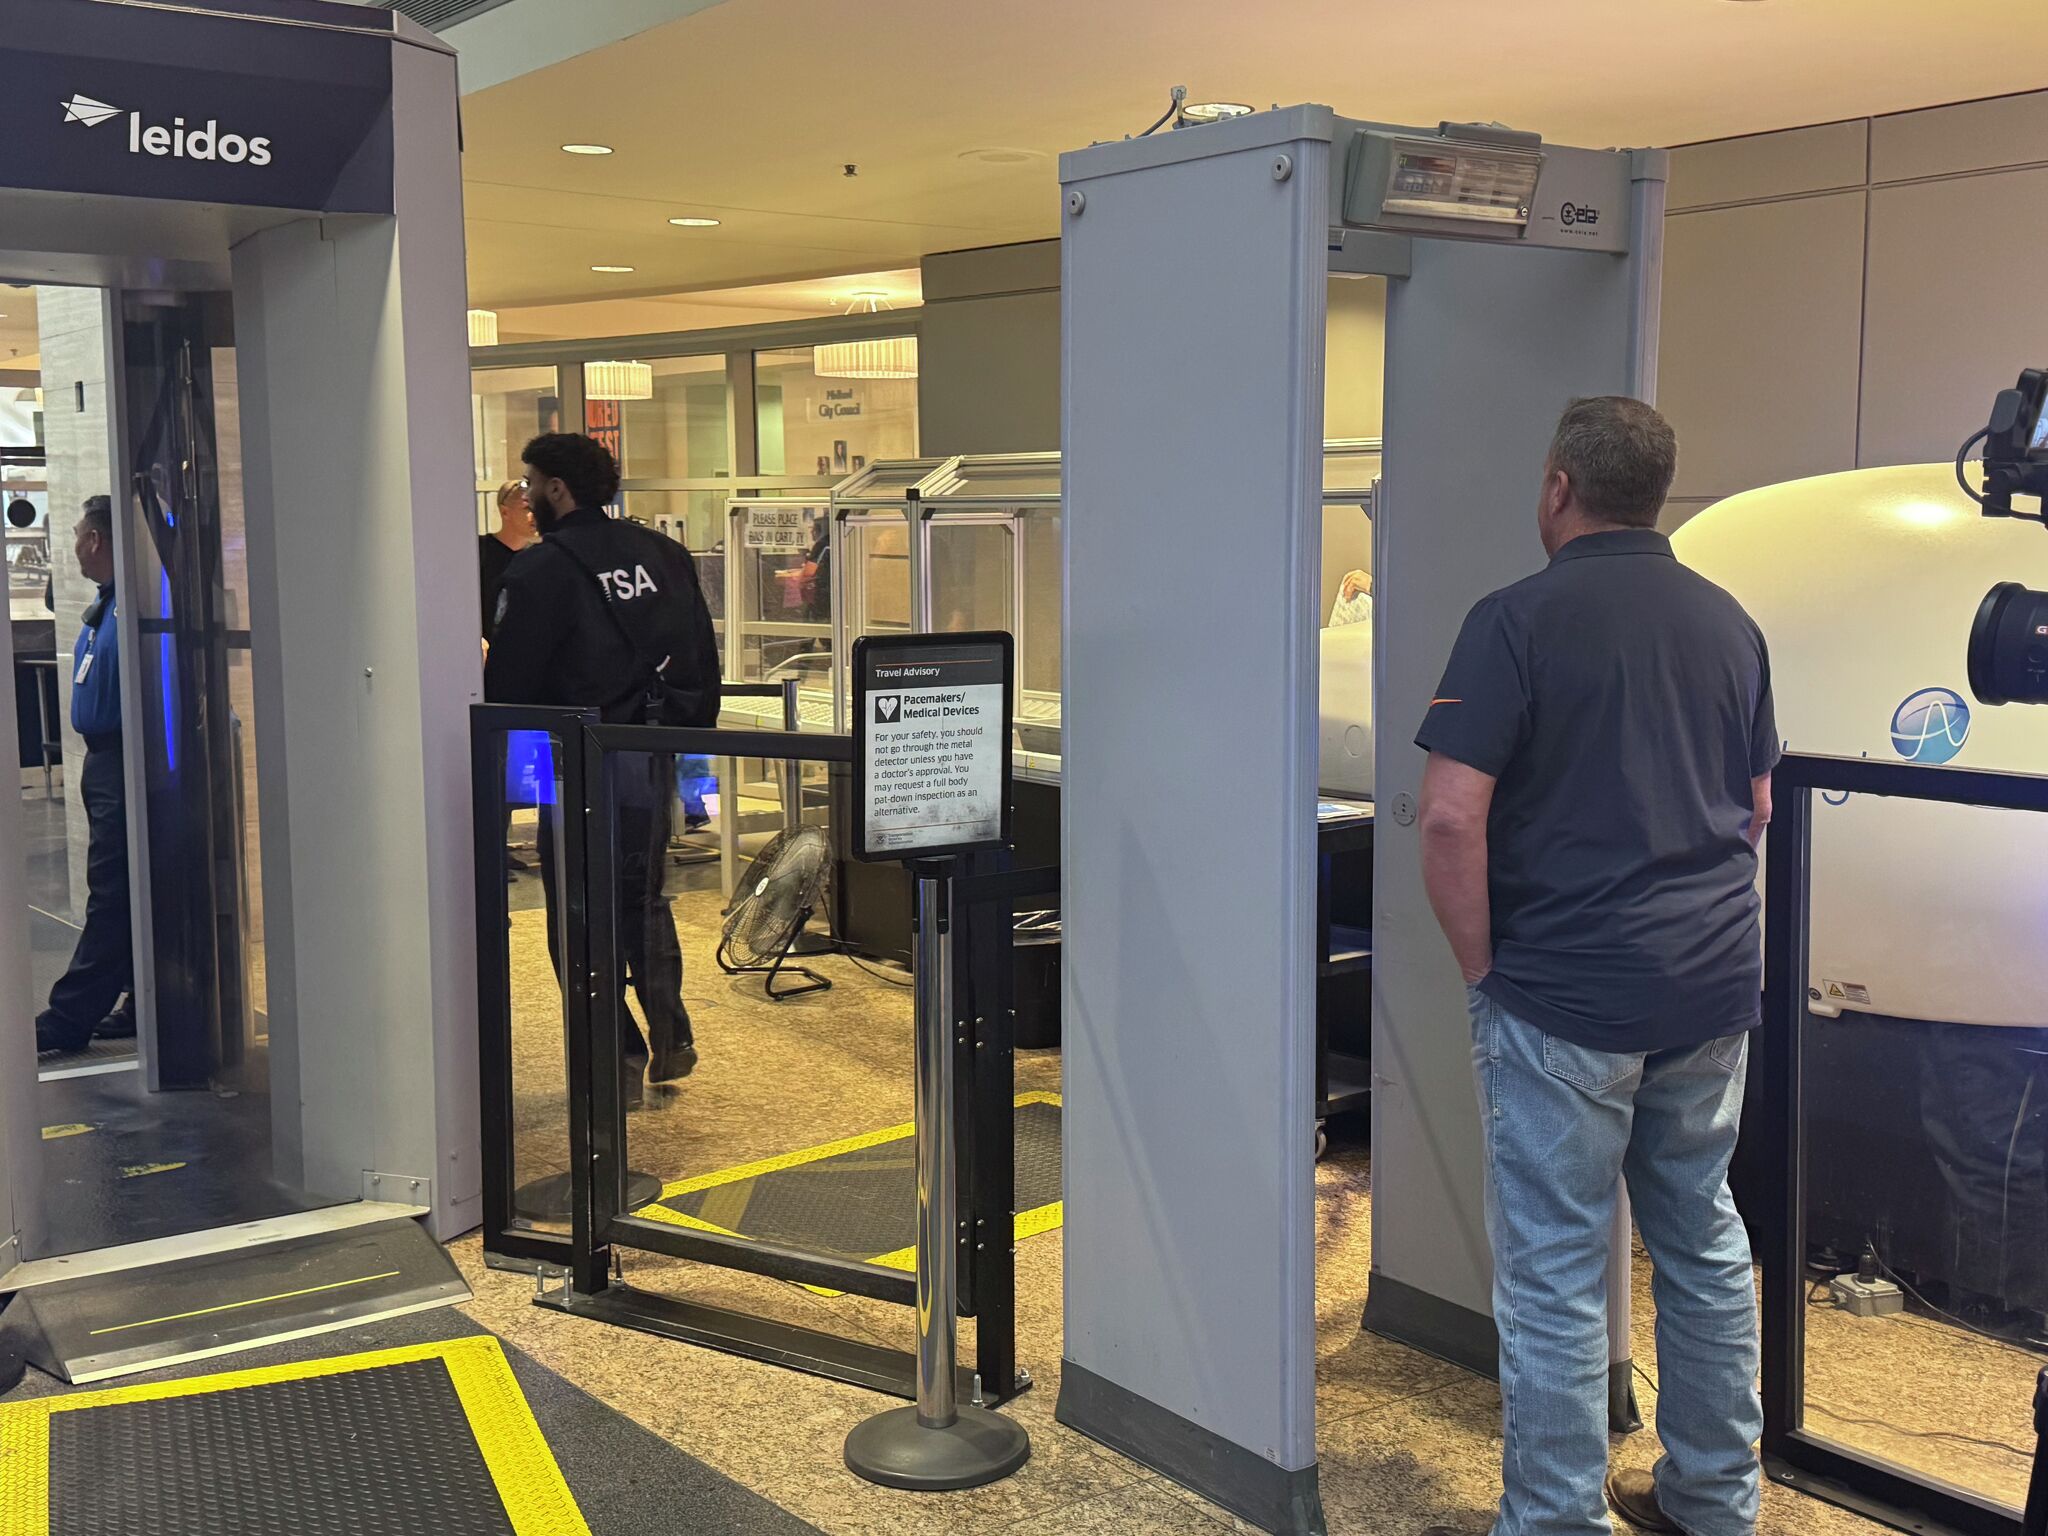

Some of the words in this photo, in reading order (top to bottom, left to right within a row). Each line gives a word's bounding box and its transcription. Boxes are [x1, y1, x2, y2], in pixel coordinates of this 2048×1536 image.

[130, 111, 272, 166] leidos
[752, 513, 776, 525] PLEASE
[777, 513, 798, 525] PLACE
[748, 531, 764, 542] BINS
[596, 564, 658, 602] TSA
[875, 668, 902, 678] Travel
[903, 667, 940, 677] Advisory
[903, 692, 966, 705] Pacemakers/
[903, 707, 940, 719] Medical
[943, 706, 980, 717] Devices
[875, 733, 888, 742] For
[891, 732, 909, 742] your
[911, 730, 938, 740] safety,
[940, 730, 955, 740] you
[957, 727, 983, 737] should
[874, 746, 888, 754] not
[890, 746, 900, 755] go
[902, 742, 934, 752] through
[936, 741, 949, 750] the
[951, 739, 973, 749] metal
[874, 757, 908, 767] detector
[910, 754, 936, 764] unless
[937, 754, 952, 763] you
[954, 752, 974, 761] have
[881, 768, 914, 778] doctor's
[915, 766, 952, 777] approval.
[954, 765, 970, 773] You
[874, 784, 892, 792] may
[894, 781, 924, 791] request
[933, 778, 946, 787] full
[948, 777, 968, 787] body
[874, 793, 913, 805] pat-down
[914, 790, 956, 802] inspection
[957, 790, 966, 798] as
[967, 789, 978, 797] an
[874, 806, 920, 817] alternative.
